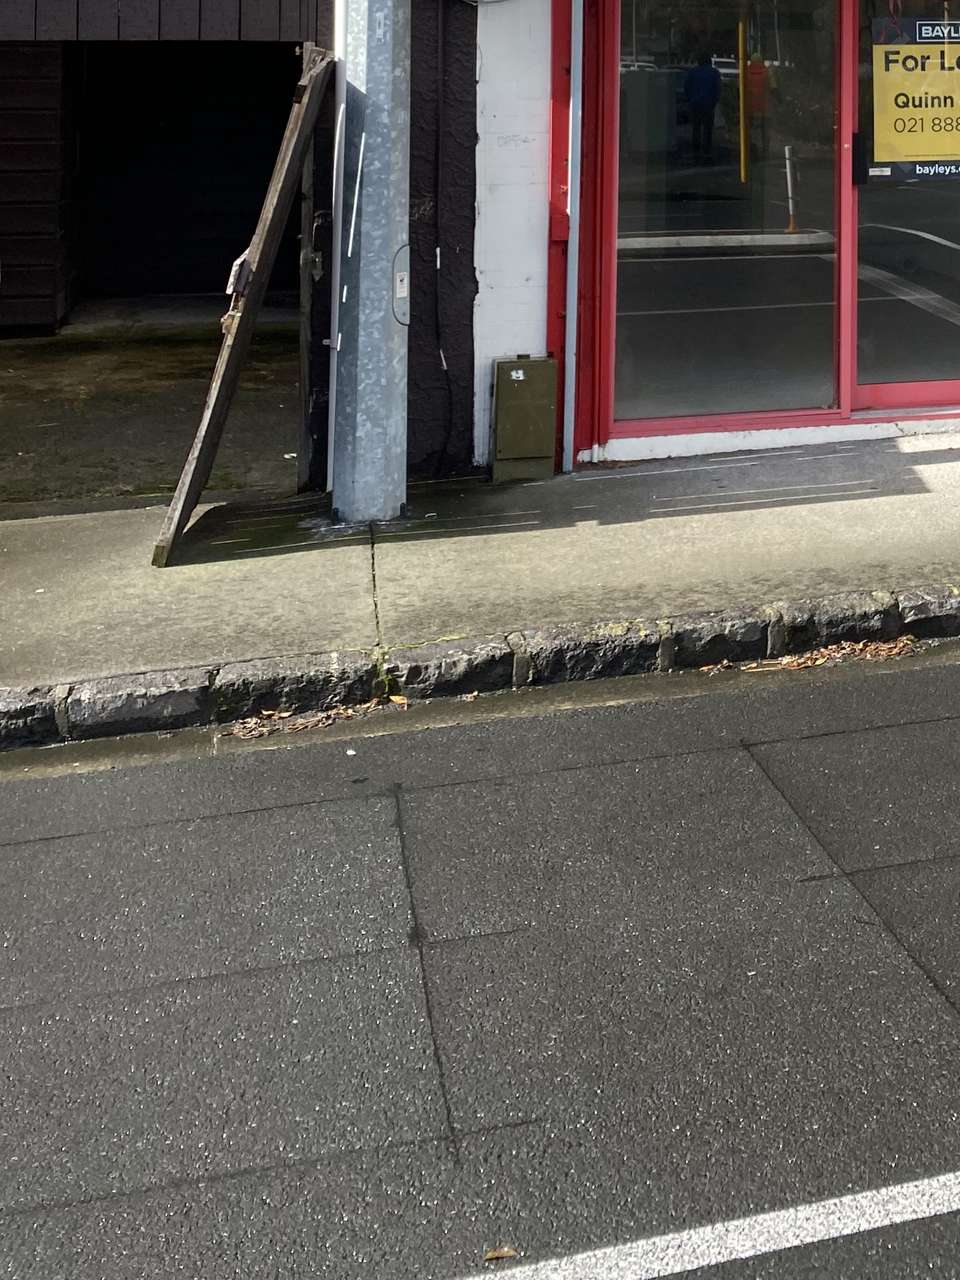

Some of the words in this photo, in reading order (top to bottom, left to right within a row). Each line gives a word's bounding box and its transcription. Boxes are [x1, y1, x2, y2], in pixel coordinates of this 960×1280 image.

[884, 50, 931, 72] For
[894, 92, 955, 110] Quinn
[894, 117, 926, 133] 021
